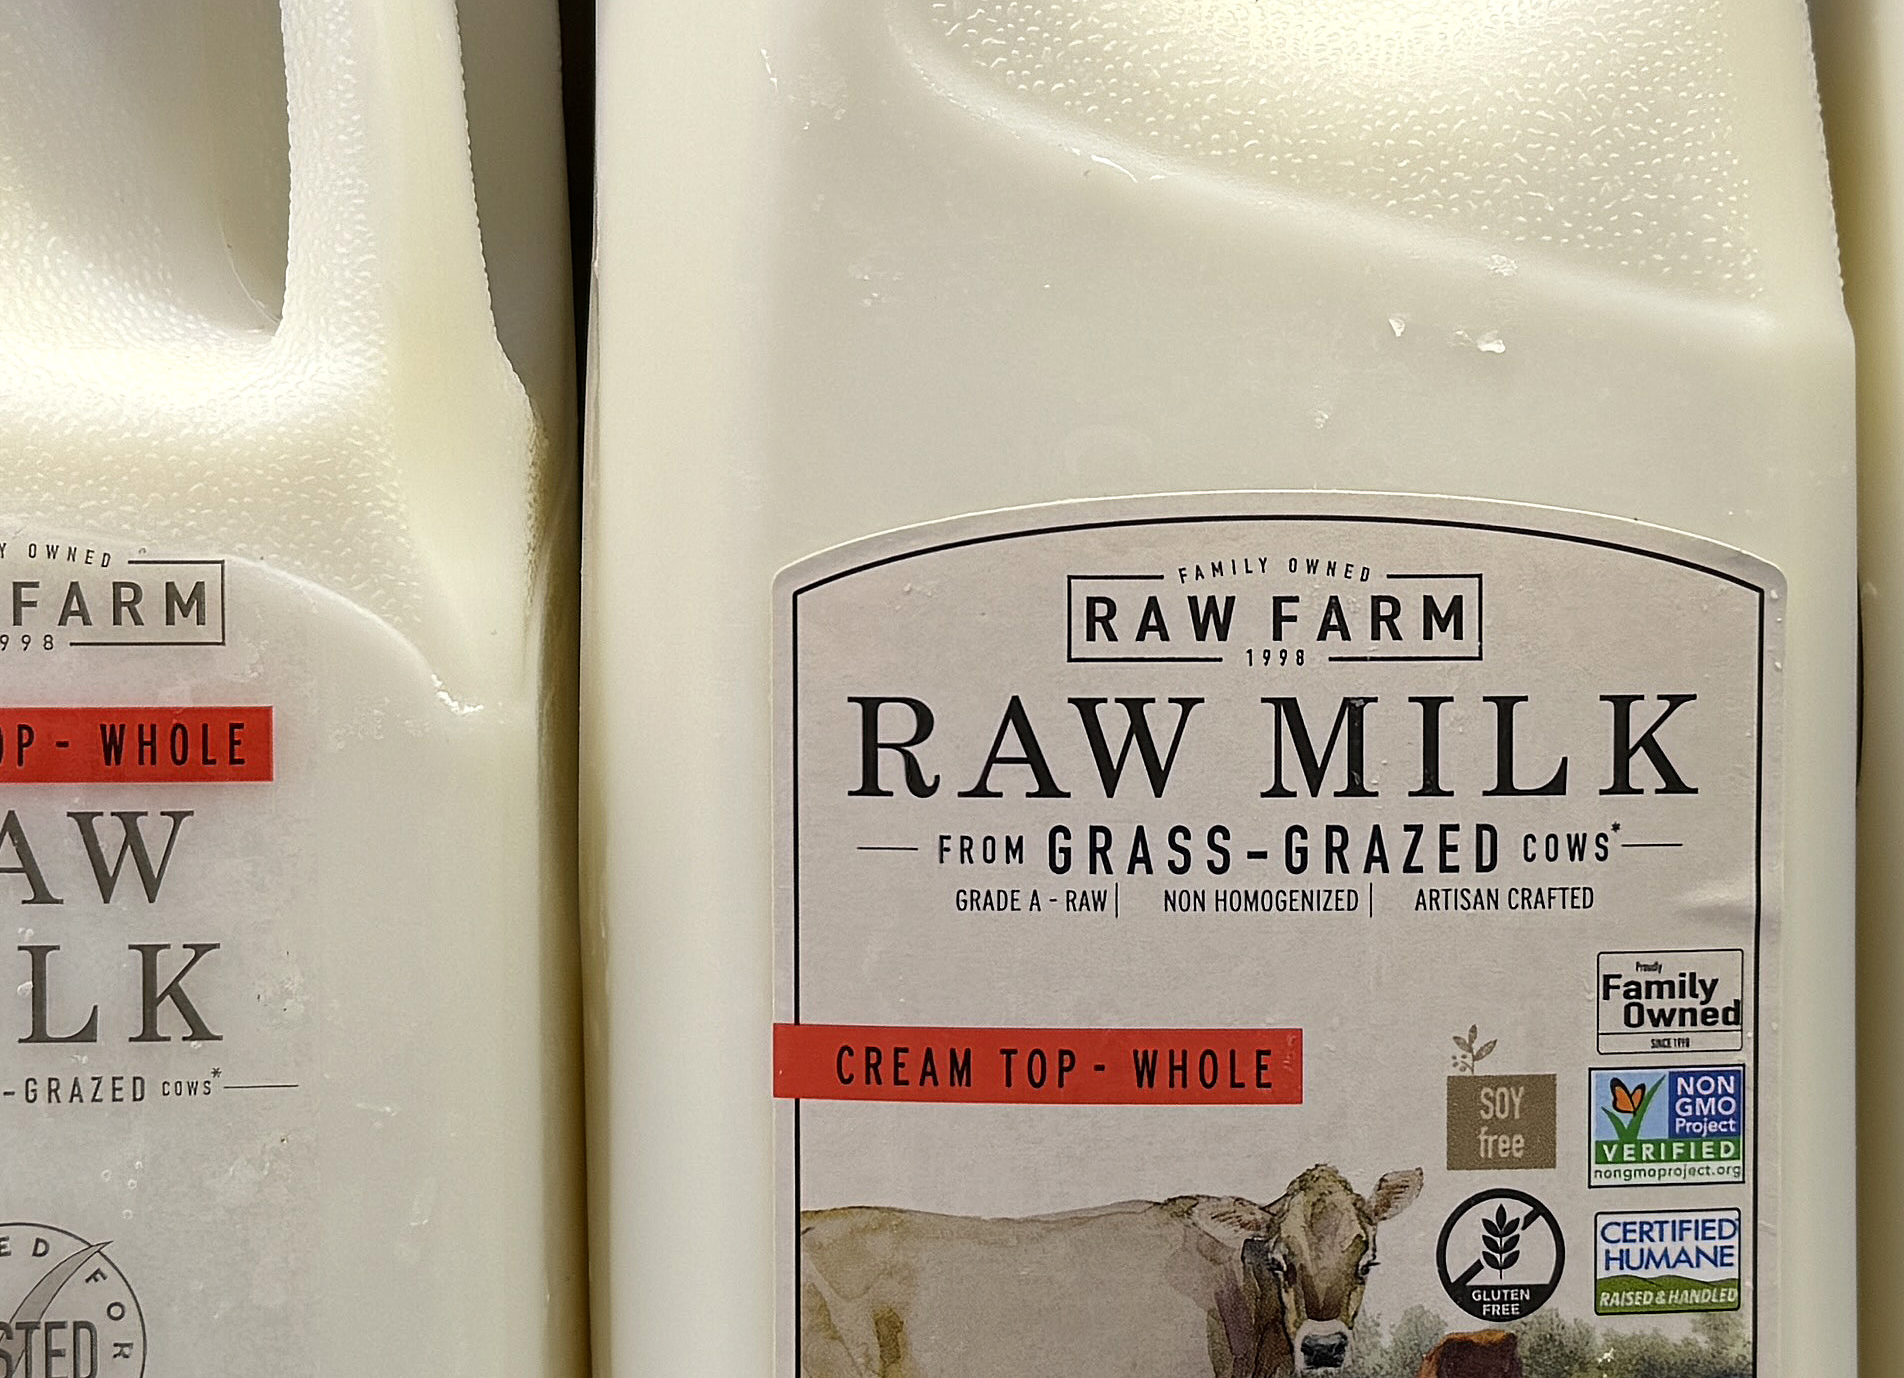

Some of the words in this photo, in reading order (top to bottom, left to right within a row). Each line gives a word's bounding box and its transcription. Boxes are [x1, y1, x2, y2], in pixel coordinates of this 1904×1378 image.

[28, 543, 112, 568] OWNED
[1179, 557, 1267, 583] FAMILY
[1288, 557, 1370, 582] OWNED
[12, 580, 206, 627] FARM
[1086, 595, 1235, 642] RAW
[1272, 594, 1464, 641] FARM
[1245, 649, 1305, 666] 1998
[100, 723, 245, 766] WHOLE
[848, 695, 1204, 798] RAW
[1260, 694, 1698, 798] MILK
[939, 835, 1024, 865] FROM
[1048, 824, 1497, 875] GRASS-GRAZED
[956, 889, 1021, 912] GRADE
[1029, 889, 1041, 912] A
[1066, 889, 1107, 912] RAW
[1164, 889, 1205, 912] NON
[1215, 889, 1359, 912] HOMOGENIZED
[1415, 887, 1499, 911] ARTISAN
[1508, 886, 1594, 910] CRAFTED
[1602, 972, 1719, 1005] Family
[1623, 1000, 1741, 1028] Owned
[837, 1045, 972, 1087] CREAM
[1000, 1048, 1077, 1088] TOP
[1133, 1049, 1273, 1089] WHOLE
[1677, 1076, 1734, 1095] NON
[1676, 1097, 1736, 1116] GMO
[1602, 1141, 1735, 1162] VERIFIED
[1600, 1218, 1739, 1245] CERTIFIED
[1604, 1245, 1734, 1271] HUMANE
